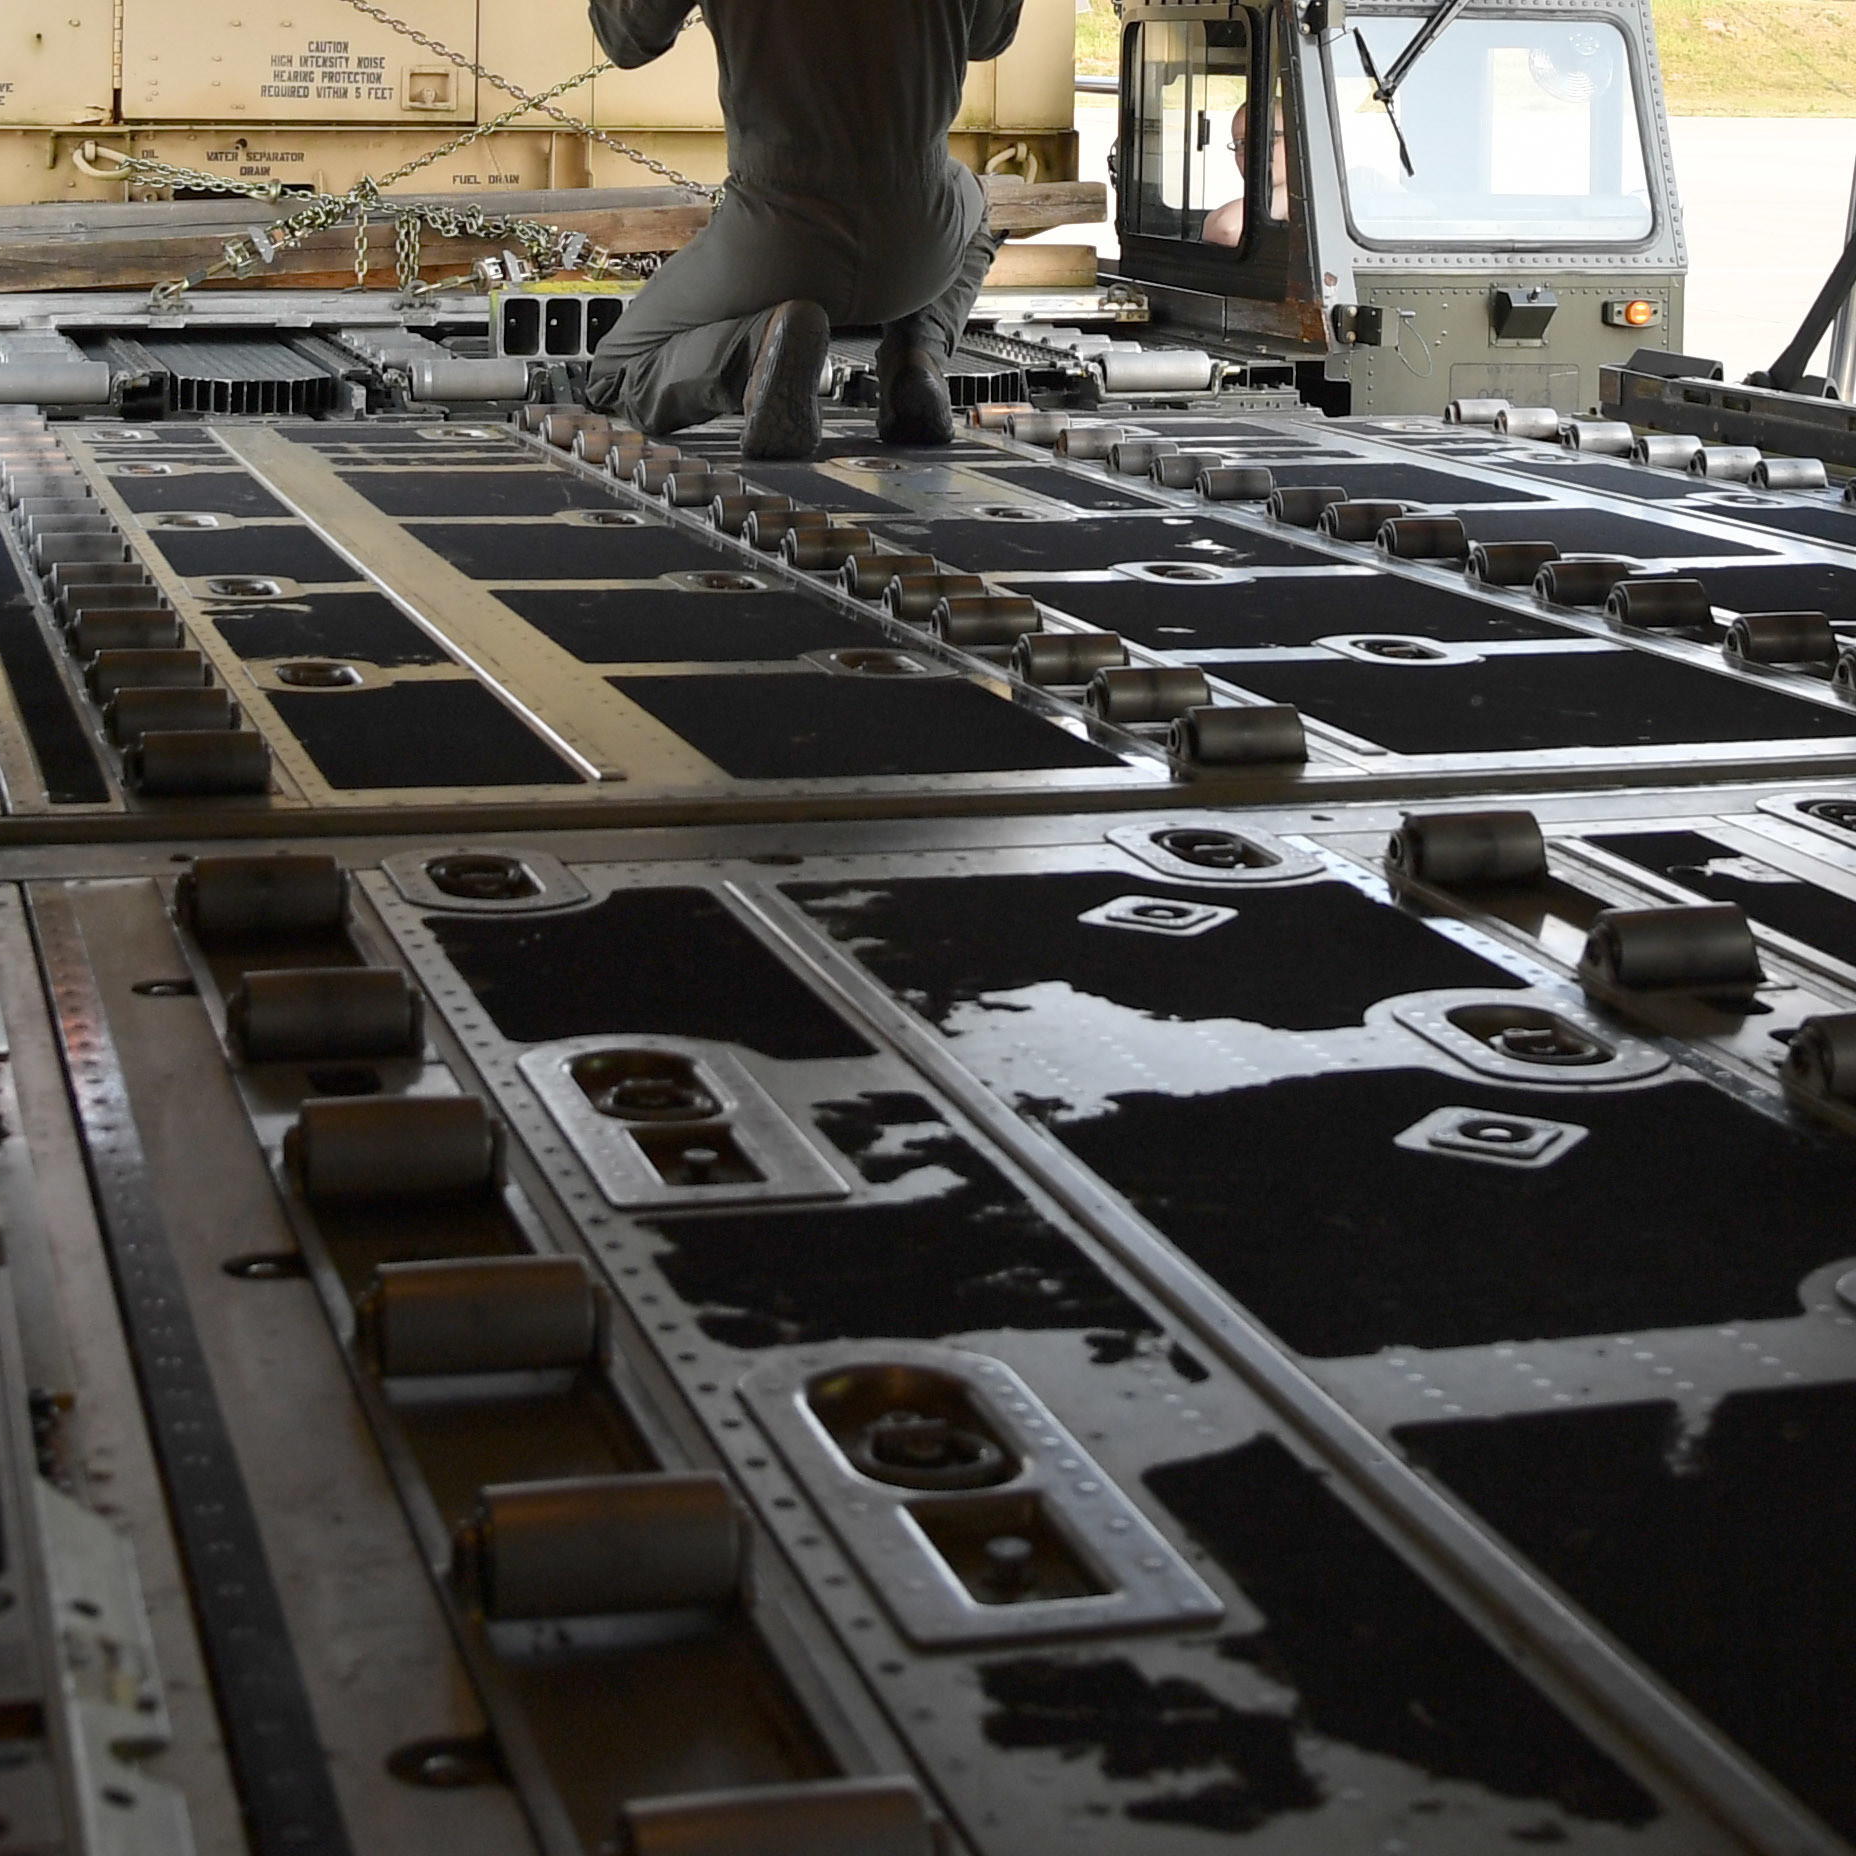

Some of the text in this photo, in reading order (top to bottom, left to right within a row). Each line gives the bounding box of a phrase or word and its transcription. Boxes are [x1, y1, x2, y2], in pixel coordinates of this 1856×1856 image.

[307, 41, 350, 54] CAUTION
[270, 55, 386, 69] HIGH INTENSITY NOISE
[273, 70, 383, 85] HEARING PROTECTION
[260, 85, 394, 101] REQUIRED WITHIN 5 FEET
[141, 149, 159, 159] OIL
[206, 152, 305, 163] WATER SEPARATOR
[240, 166, 270, 176] DRAIN
[452, 175, 520, 185] FUEL DRAIN
